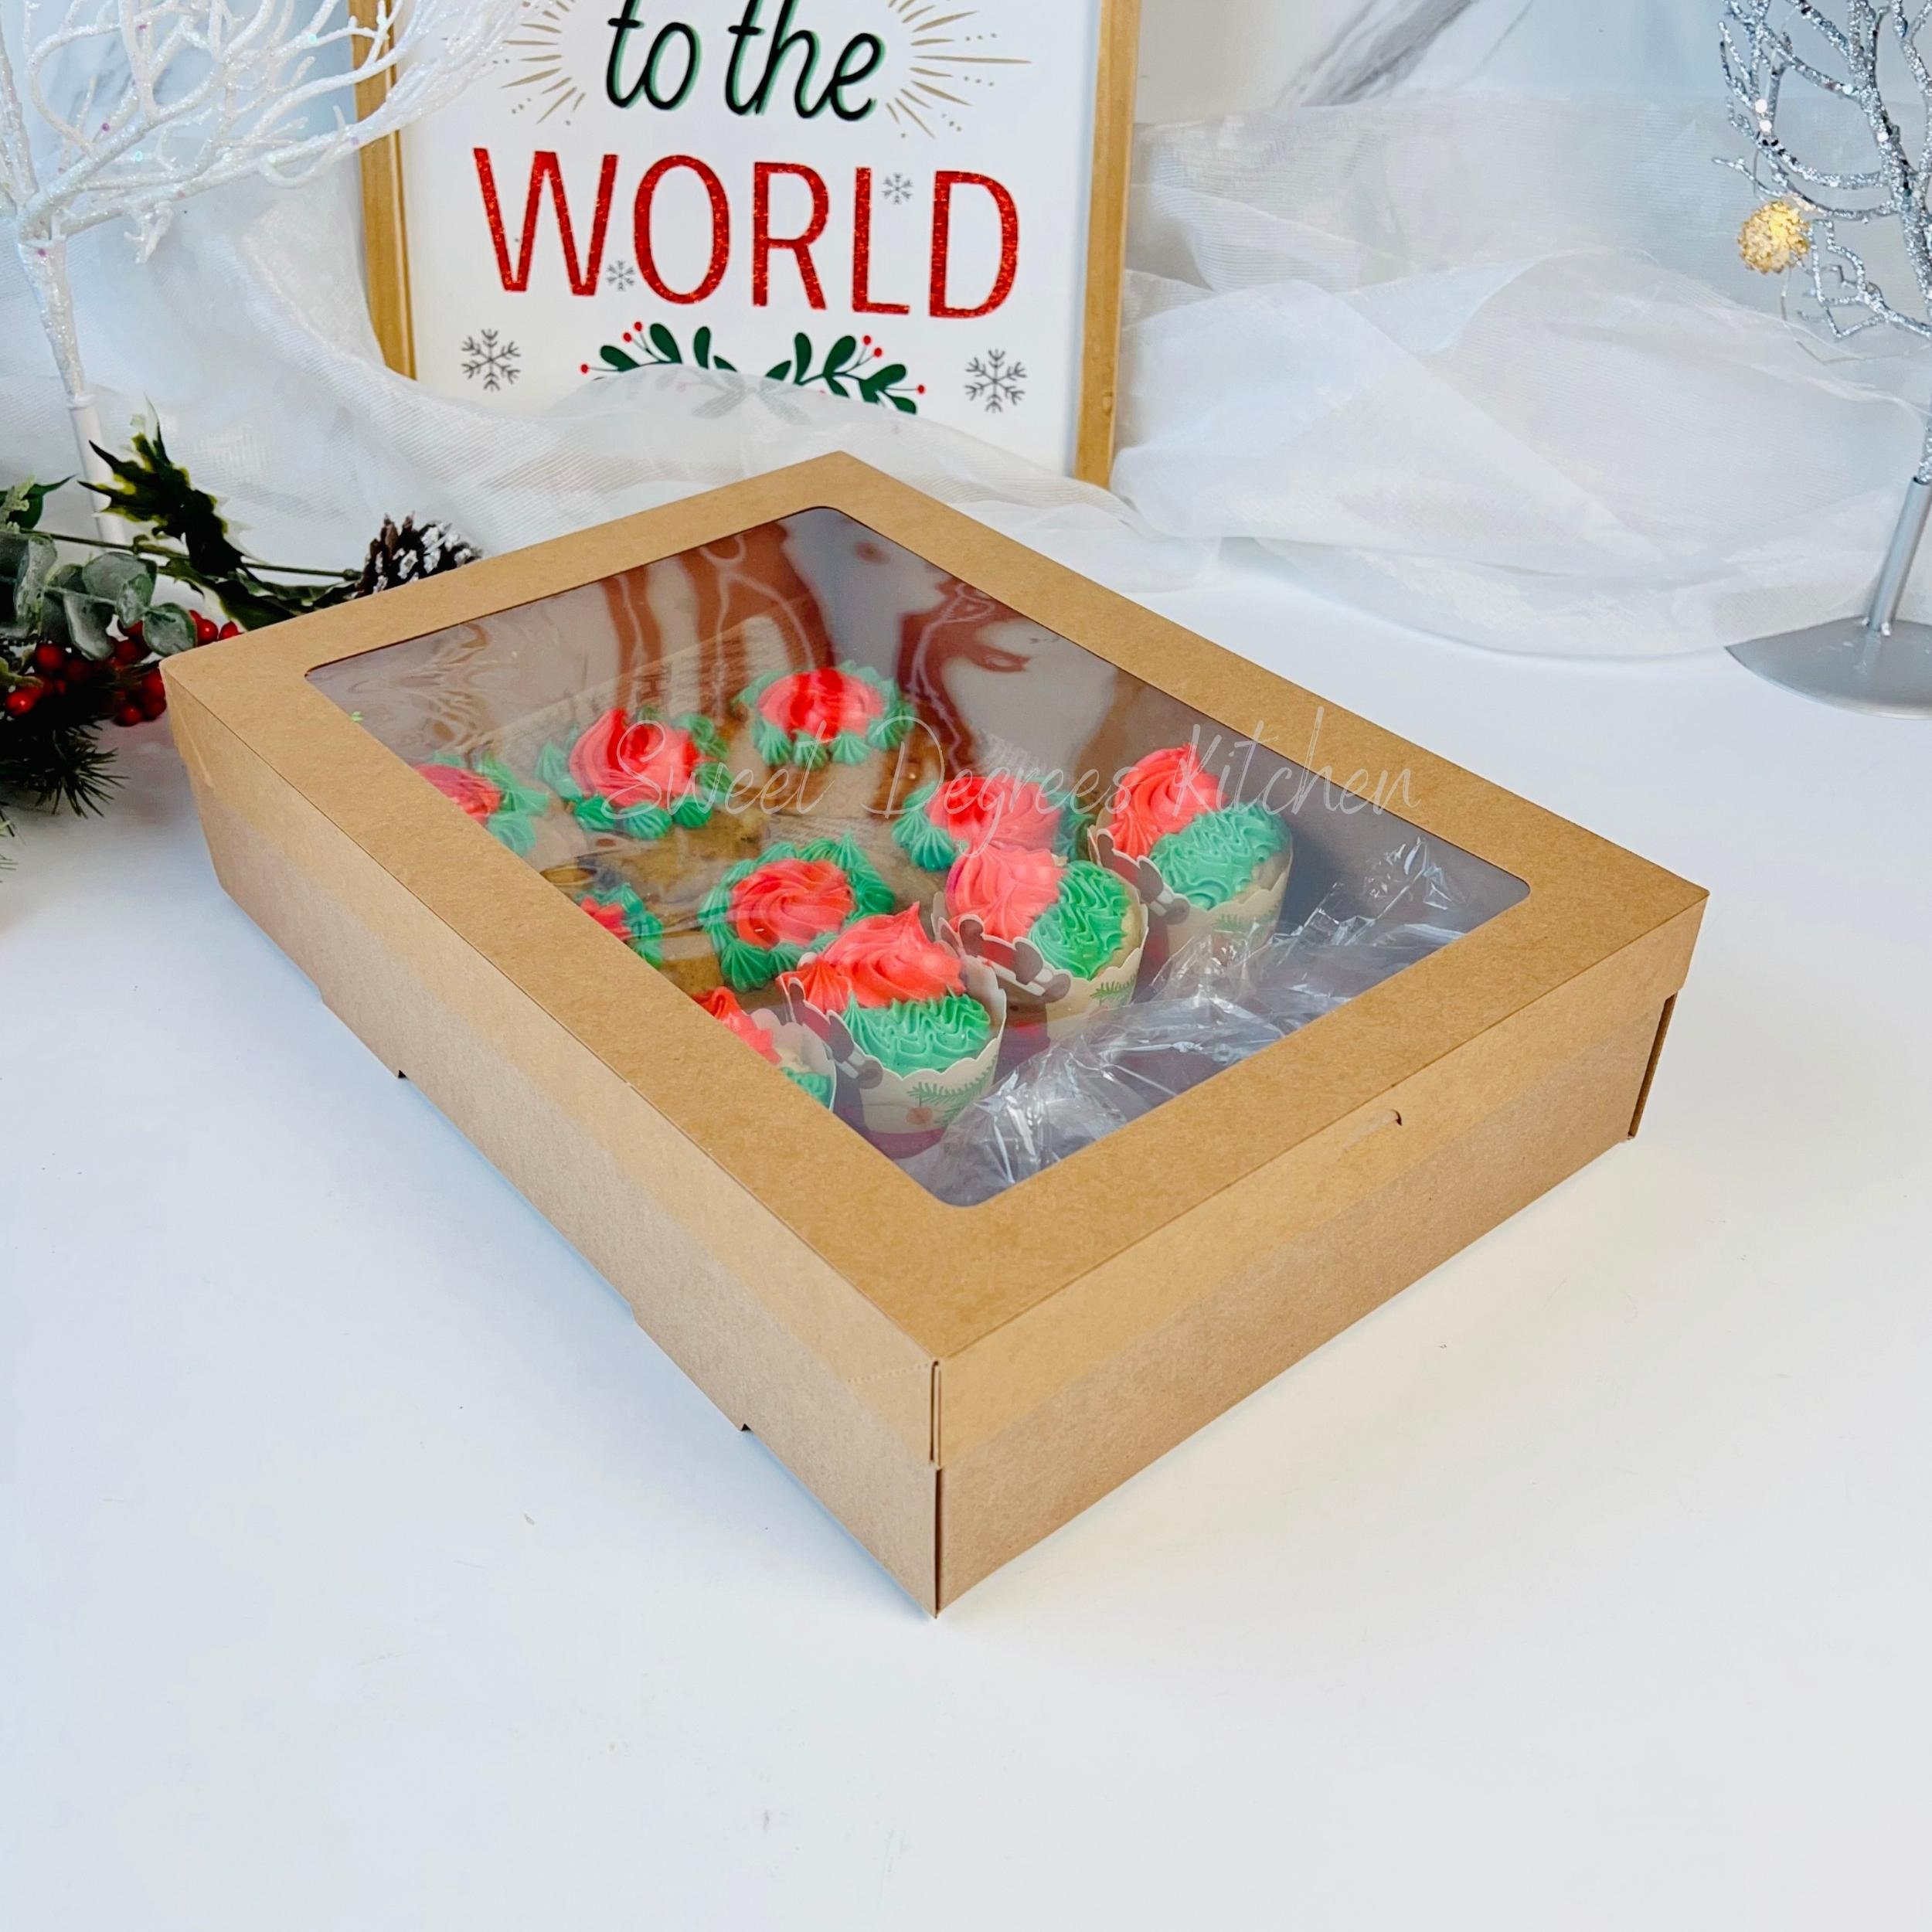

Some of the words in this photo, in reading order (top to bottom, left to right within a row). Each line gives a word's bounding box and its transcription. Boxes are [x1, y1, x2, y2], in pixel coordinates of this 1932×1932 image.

[606, 0, 701, 111] to
[724, 0, 886, 121] the
[472, 147, 1020, 319] WORLD
